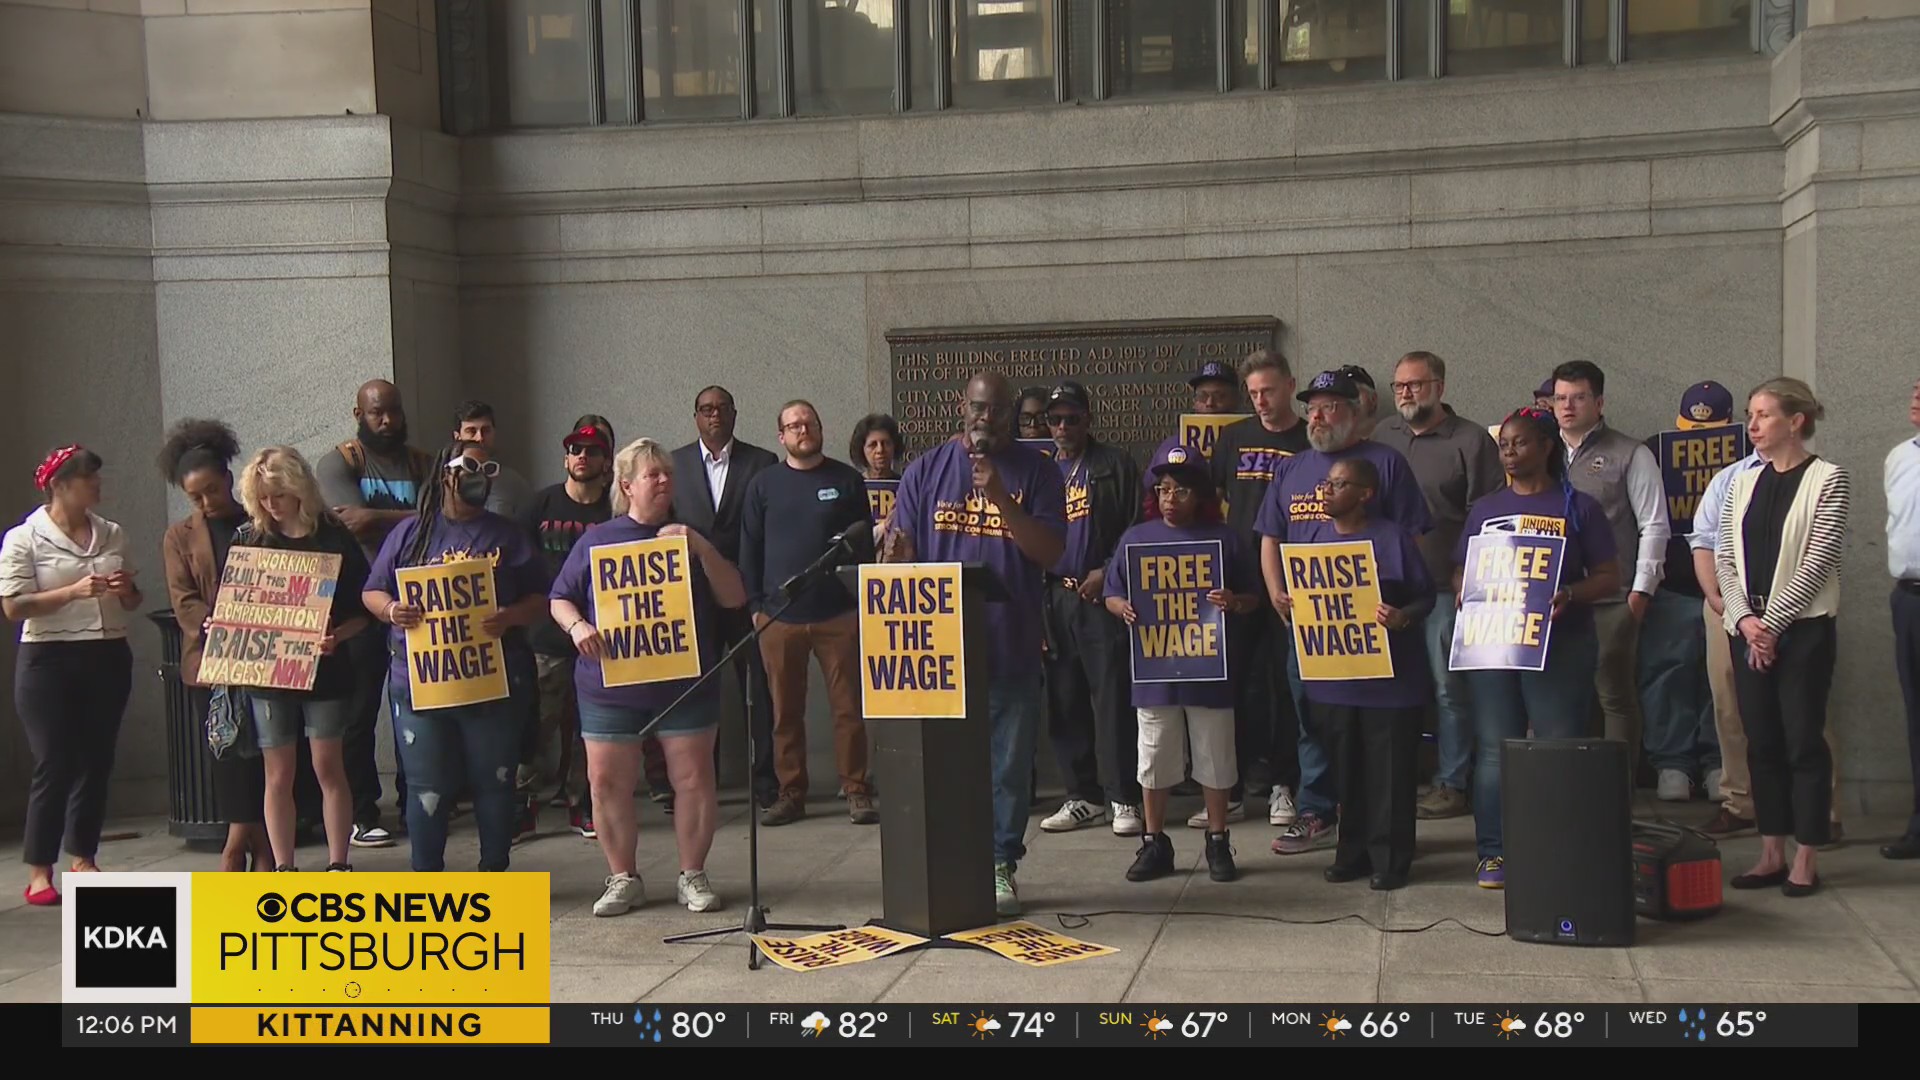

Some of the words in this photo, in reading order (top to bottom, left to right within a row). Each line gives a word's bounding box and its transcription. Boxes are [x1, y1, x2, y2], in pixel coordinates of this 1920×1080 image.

[898, 352, 930, 367] THIS
[936, 350, 1004, 366] BUILDING
[1010, 347, 1081, 363] ERECTED
[1119, 345, 1146, 360] 1915
[1155, 343, 1184, 359] 1917
[1198, 342, 1227, 357] FOR
[897, 367, 930, 381] CITY
[932, 366, 951, 380] OF
[956, 363, 1044, 380] PITBURGH
[1047, 363, 1081, 377] AND
[1084, 361, 1148, 376] COUNTY
[1152, 359, 1170, 374] OF
[897, 389, 931, 403] CITY
[1112, 380, 1197, 397] ARMSTRON
[899, 404, 937, 419] JOHN
[1150, 396, 1189, 412] JOHN
[897, 419, 953, 434] ROBERT
[1671, 434, 1737, 470] FREE
[867, 489, 897, 517] FR
[933, 510, 980, 526] GOOD
[982, 515, 1009, 529] JO
[1522, 517, 1561, 530] UNIONS
[223, 565, 266, 587] BUILT
[266, 575, 287, 588] THIS
[257, 552, 318, 575] WORKING
[599, 549, 683, 592] RAISE
[1140, 553, 1214, 590] FREE
[1289, 554, 1372, 590] RAISE
[1475, 545, 1552, 582] FREE
[233, 588, 256, 604] WE
[405, 571, 490, 613] RAISE
[617, 589, 666, 622] THE
[867, 577, 955, 615] RAISE
[1152, 592, 1199, 621] THE
[1483, 581, 1528, 609] THE
[1308, 593, 1357, 622] THE
[205, 626, 283, 661] RAISE
[283, 640, 316, 656] THE
[425, 613, 473, 646] THE
[603, 619, 690, 661] WAGE
[884, 620, 935, 651] THE
[1138, 623, 1218, 659] WAGE
[1299, 622, 1382, 657] WAGE
[1462, 612, 1544, 647] WAGE
[413, 642, 498, 684] WAGE
[867, 655, 957, 691] WAGE
[810, 938, 857, 958] THE
[828, 930, 901, 954] WAGE
[966, 927, 1054, 945] WAGE
[1008, 937, 1062, 951] THE
[763, 939, 840, 968] RAISE
[1013, 943, 1104, 963] RAISE
